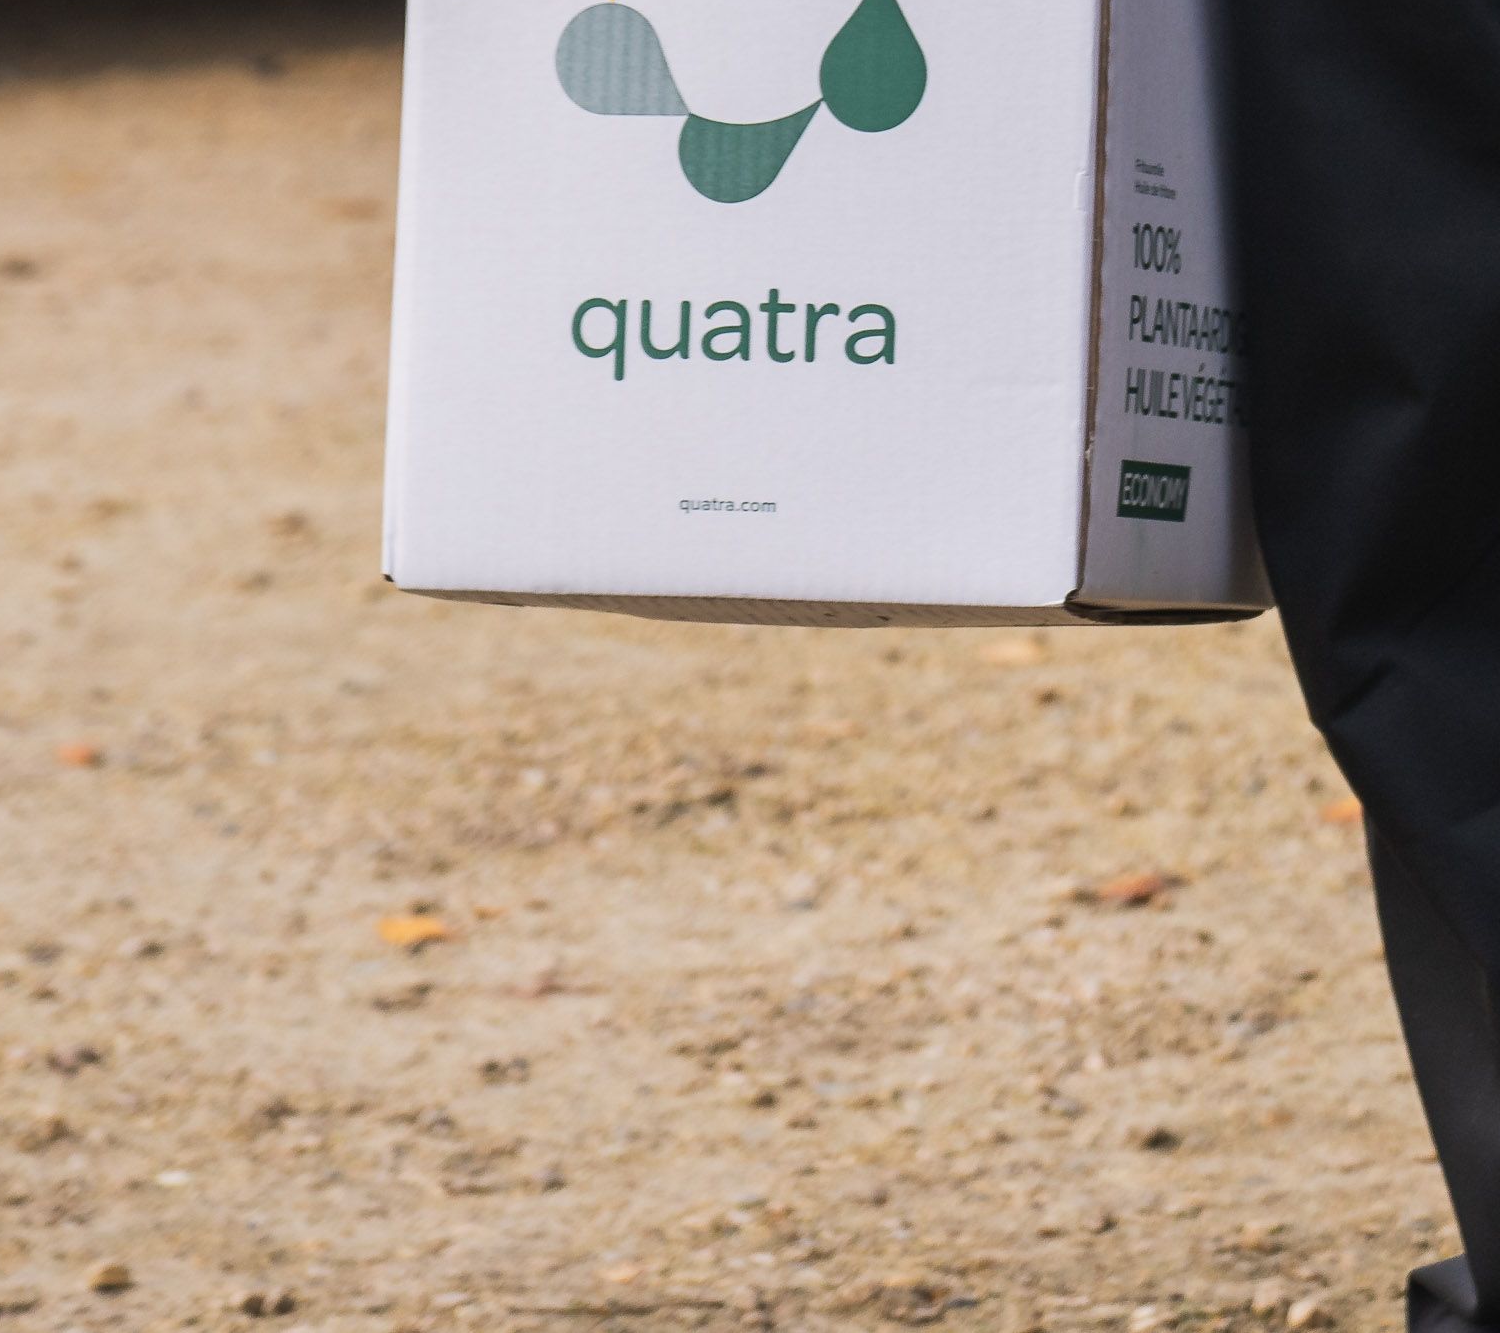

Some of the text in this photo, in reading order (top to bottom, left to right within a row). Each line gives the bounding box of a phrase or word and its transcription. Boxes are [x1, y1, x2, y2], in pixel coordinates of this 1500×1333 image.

[1132, 222, 1183, 275] 100%
[572, 288, 898, 382] quatra
[1128, 294, 1246, 355] PLANTAARD
[1124, 366, 1179, 418] HUILE
[679, 498, 778, 515] quatra.com
[1122, 471, 1188, 510] ECONOMY
